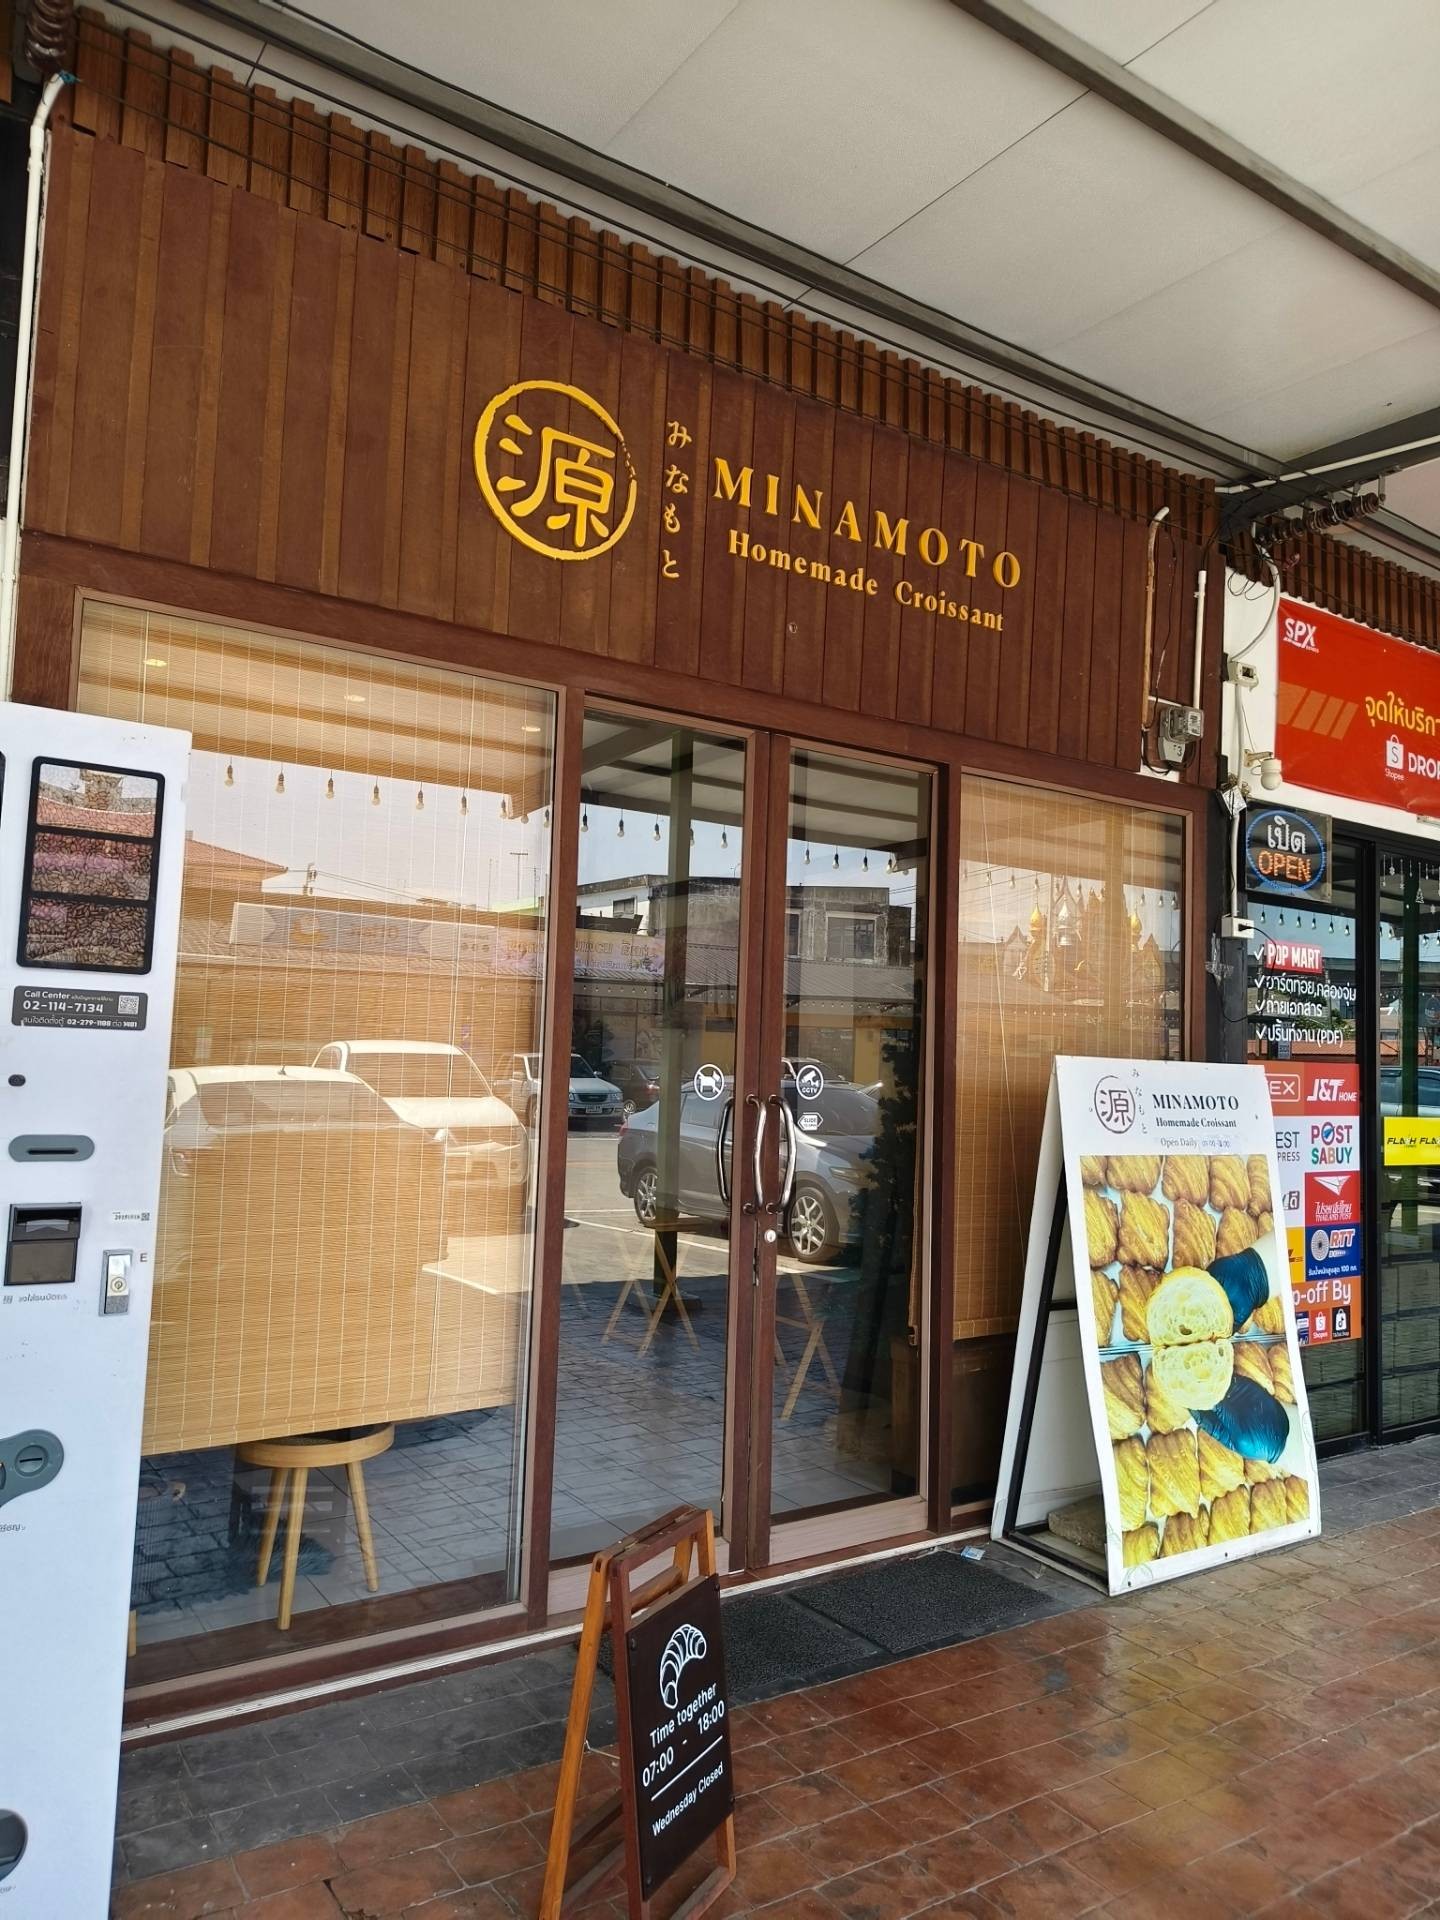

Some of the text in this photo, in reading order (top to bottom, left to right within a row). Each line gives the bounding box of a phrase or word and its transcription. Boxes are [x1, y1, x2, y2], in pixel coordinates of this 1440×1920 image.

[496, 413, 615, 547] 源
[664, 419, 692, 579] みなもと
[712, 457, 1021, 590] MINAMOTO
[727, 529, 1005, 632] Homemade Croissant
[1284, 617, 1318, 649] SPX
[1384, 767, 1405, 781] Shopee
[1267, 815, 1306, 854] เปิด
[1257, 851, 1311, 883] OPEN
[1266, 943, 1321, 970] POP MART
[22, 1000, 104, 1013] 02-114-7134
[24, 990, 71, 1000] Call Center
[1266, 995, 1323, 1017] ถ่ายเอกสาร
[1152, 1093, 1240, 1111] MINAMOTO
[1306, 1078, 1358, 1102] J&T HOME
[1099, 1089, 1133, 1126] 源
[1155, 1117, 1237, 1129] Homemade Croissant
[1311, 1121, 1353, 1146] POST
[1311, 1146, 1353, 1165] SABUY
[1329, 1228, 1356, 1249] RTT
[1332, 1280, 1352, 1305] By
[649, 1682, 717, 1749] Time together
[641, 1745, 675, 1788] 07:00
[697, 1700, 725, 1736] 18:00
[651, 1760, 724, 1838] Wednesday Closed
